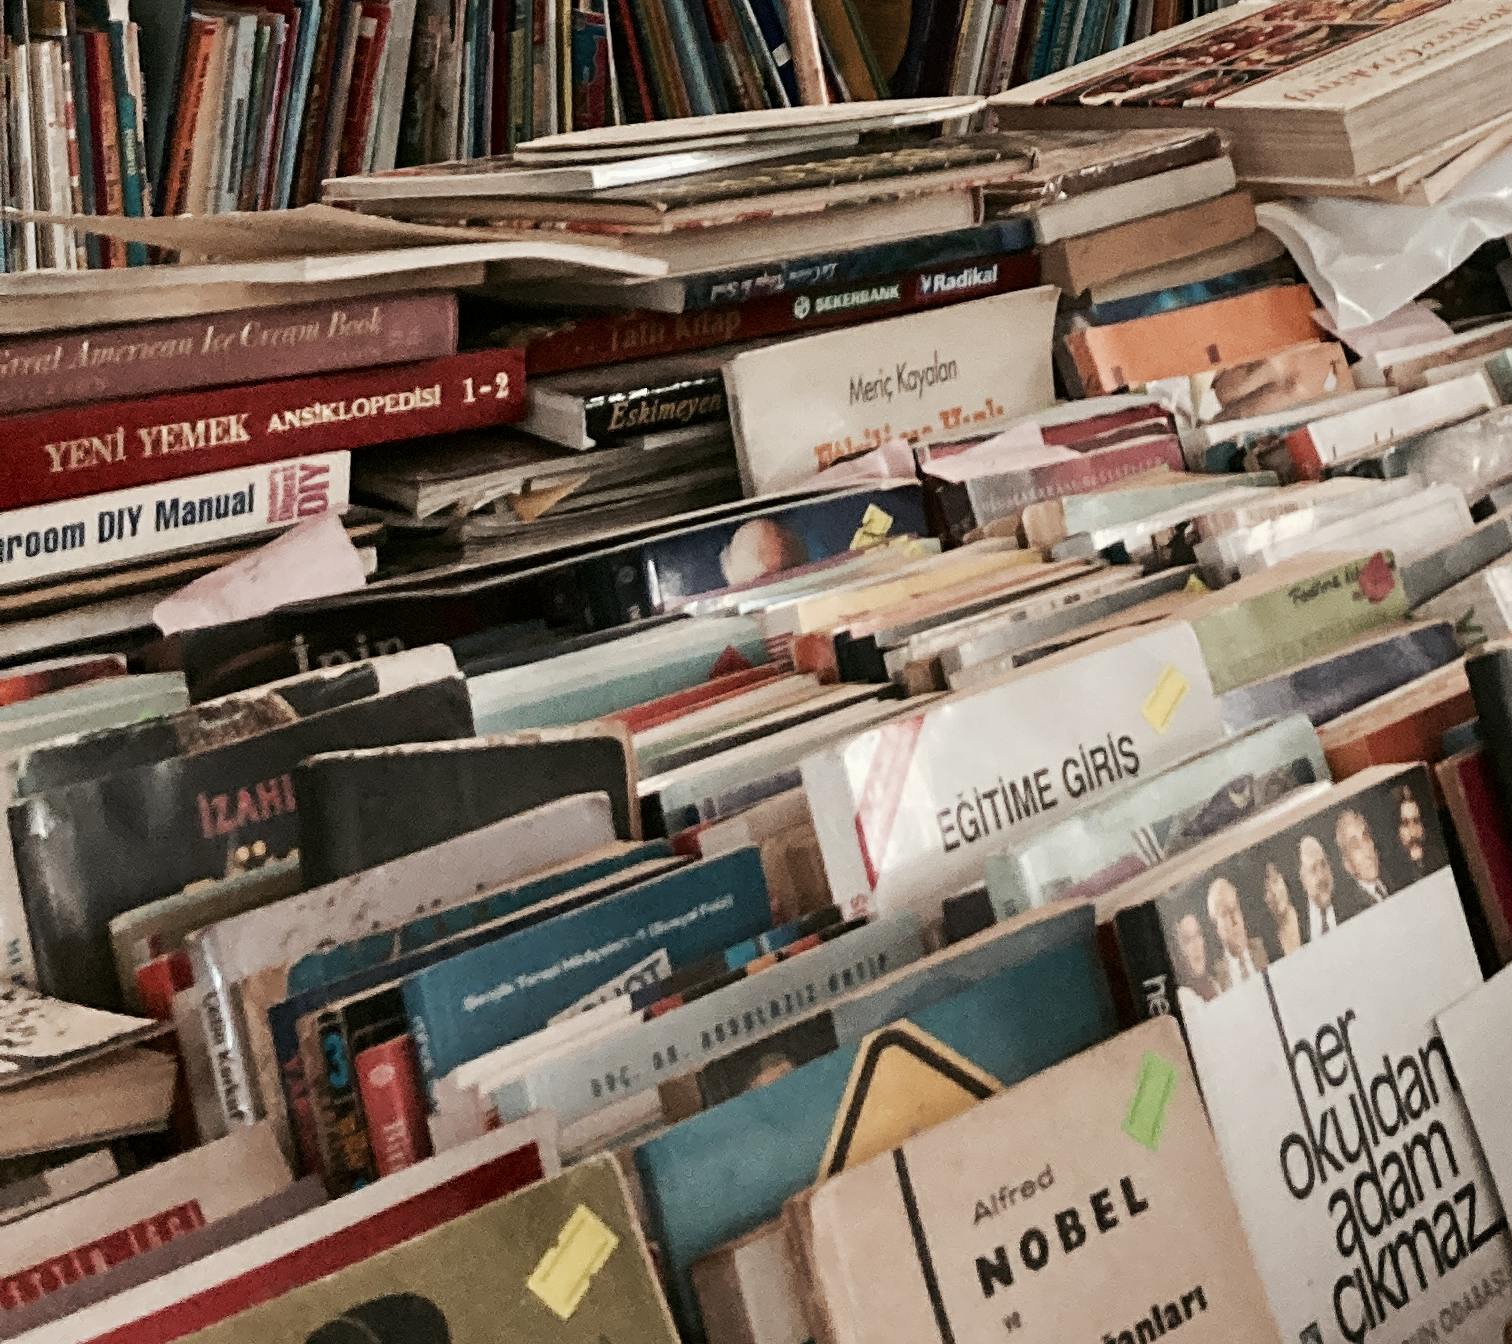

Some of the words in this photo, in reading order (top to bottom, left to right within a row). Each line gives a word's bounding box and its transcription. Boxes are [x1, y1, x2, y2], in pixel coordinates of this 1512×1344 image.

[932, 263, 998, 293] Radikal
[67, 337, 193, 374] American
[201, 325, 231, 355] Ice
[240, 318, 319, 350] Cream
[327, 306, 384, 339] Book
[849, 371, 894, 405] Meriç
[896, 349, 958, 399] Kayalan
[45, 427, 127, 475] YENİ
[136, 413, 251, 458] YEMEK
[267, 384, 442, 434] ANSİKLOPEDİSİ
[462, 371, 509, 404] 1-2
[607, 393, 721, 431] Eskimeyen
[97, 504, 141, 543] DIY
[155, 483, 256, 533] Manual
[298, 463, 330, 514] DIY
[935, 766, 1059, 853] EĞİTİME
[1284, 1009, 1357, 1098] her
[1279, 1034, 1464, 1201] okuldan
[972, 1163, 1056, 1226] Alfred
[1327, 1119, 1461, 1257] adam
[973, 1174, 1151, 1300] NOBEL
